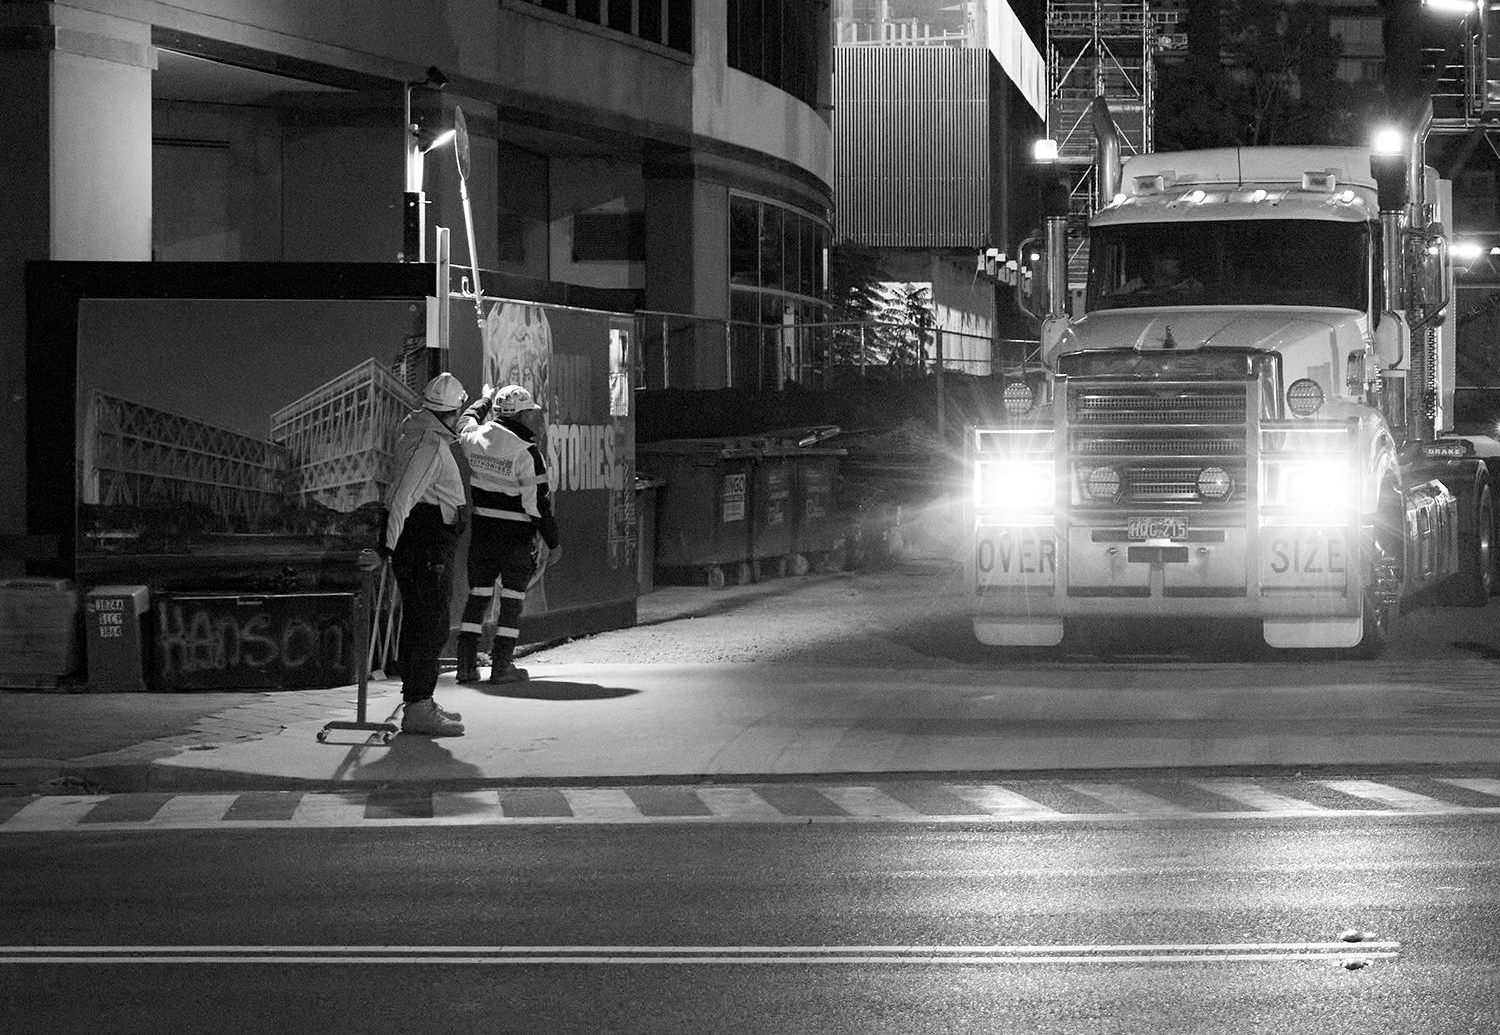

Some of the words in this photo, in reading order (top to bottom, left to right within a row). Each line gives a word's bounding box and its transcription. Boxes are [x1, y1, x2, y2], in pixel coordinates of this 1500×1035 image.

[549, 423, 615, 492] STORIES
[1162, 523, 1186, 537] 215
[978, 539, 1055, 574] OVER
[1270, 539, 1346, 574] SIZE
